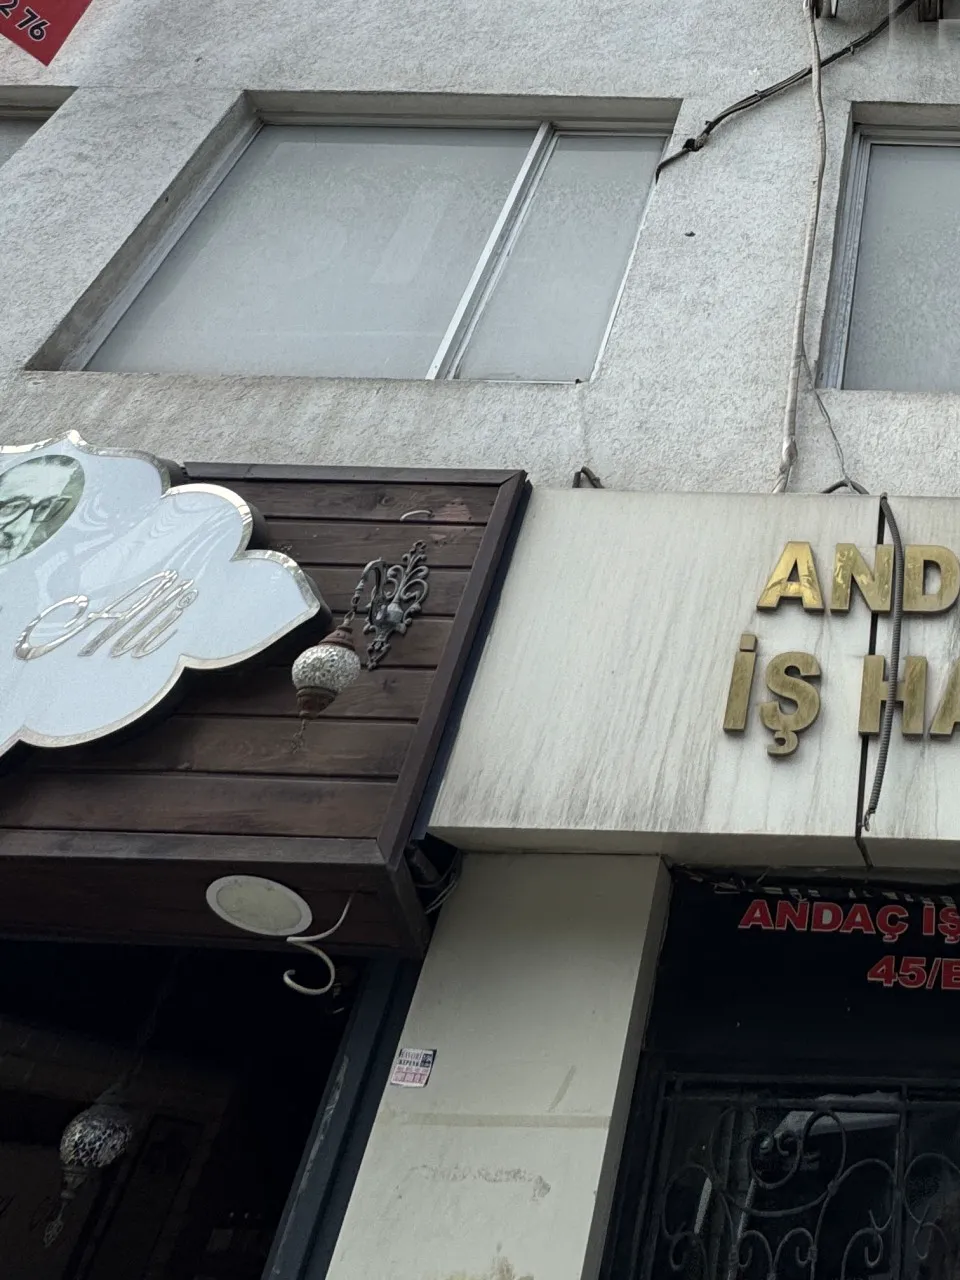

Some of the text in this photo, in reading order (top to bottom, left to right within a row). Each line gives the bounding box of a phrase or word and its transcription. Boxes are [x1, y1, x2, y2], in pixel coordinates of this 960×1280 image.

[15, 6, 51, 41] 76
[722, 633, 822, 757] İŞ
[738, 899, 908, 942] ANDAÇ
